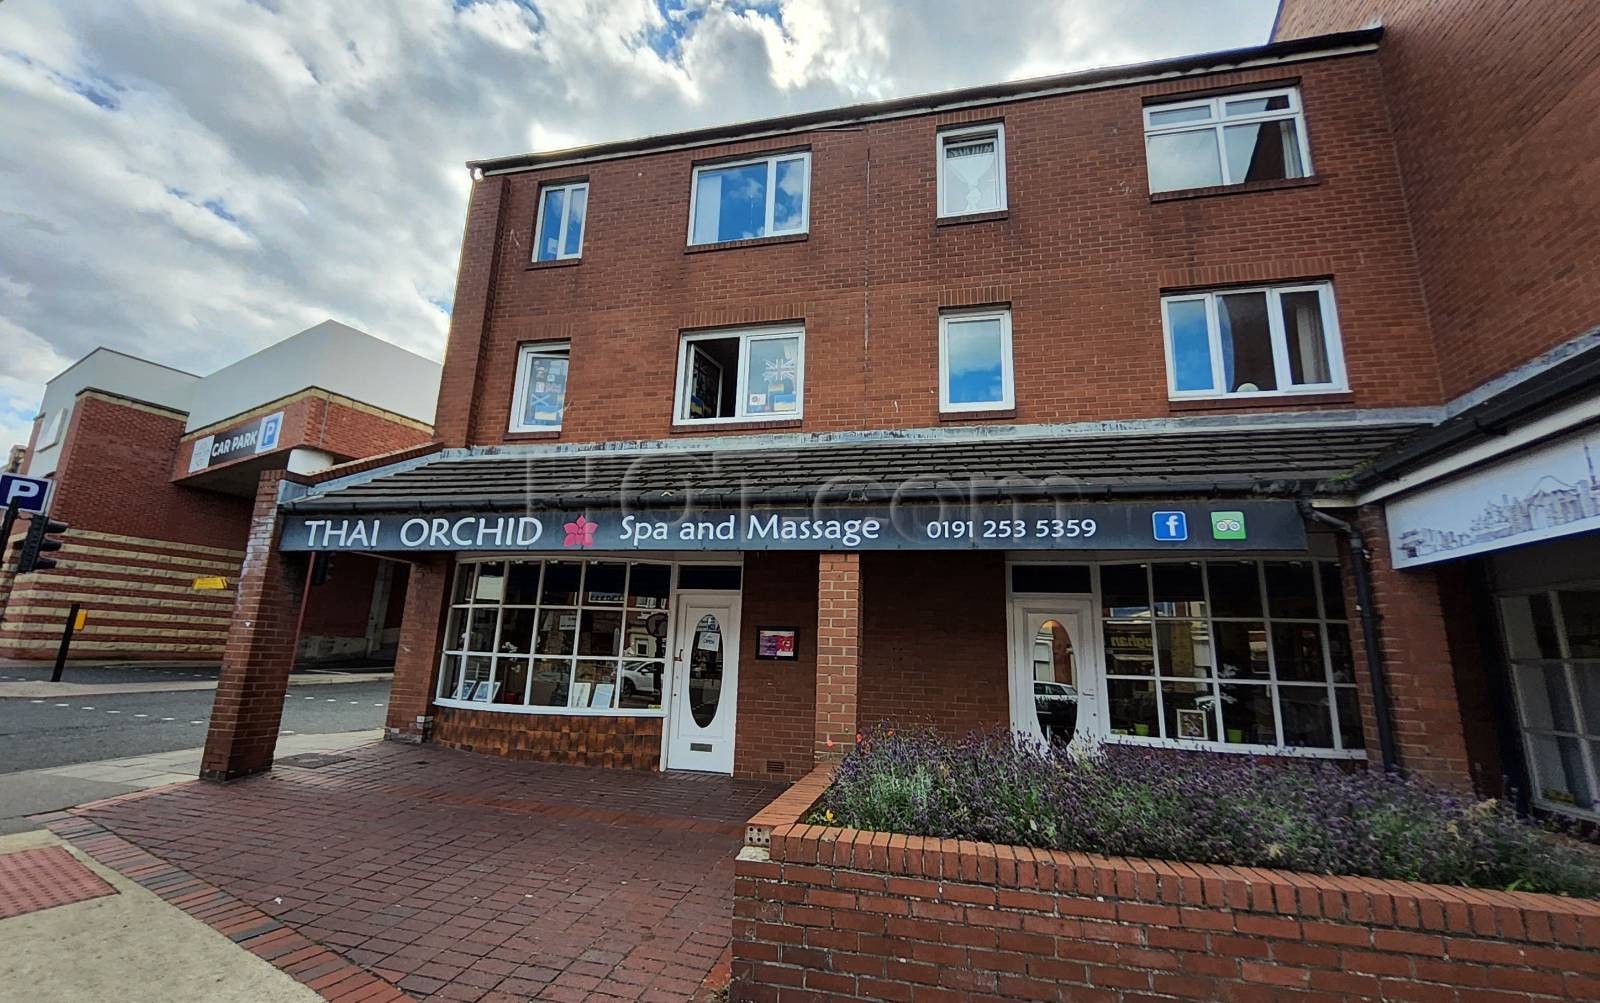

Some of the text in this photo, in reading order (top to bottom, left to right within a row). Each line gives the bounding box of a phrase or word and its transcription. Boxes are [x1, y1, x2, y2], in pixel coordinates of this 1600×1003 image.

[211, 439, 231, 457] CAR
[231, 429, 258, 451] PARK
[264, 422, 275, 444] P
[6, 479, 39, 505] P
[305, 519, 379, 547] THAI
[400, 516, 542, 547] ORCHID
[619, 515, 668, 547] Spa
[679, 514, 735, 540] and
[746, 513, 880, 547] Massage
[926, 520, 974, 539] 0191
[983, 519, 1026, 538] 253
[1035, 519, 1097, 538] 5359
